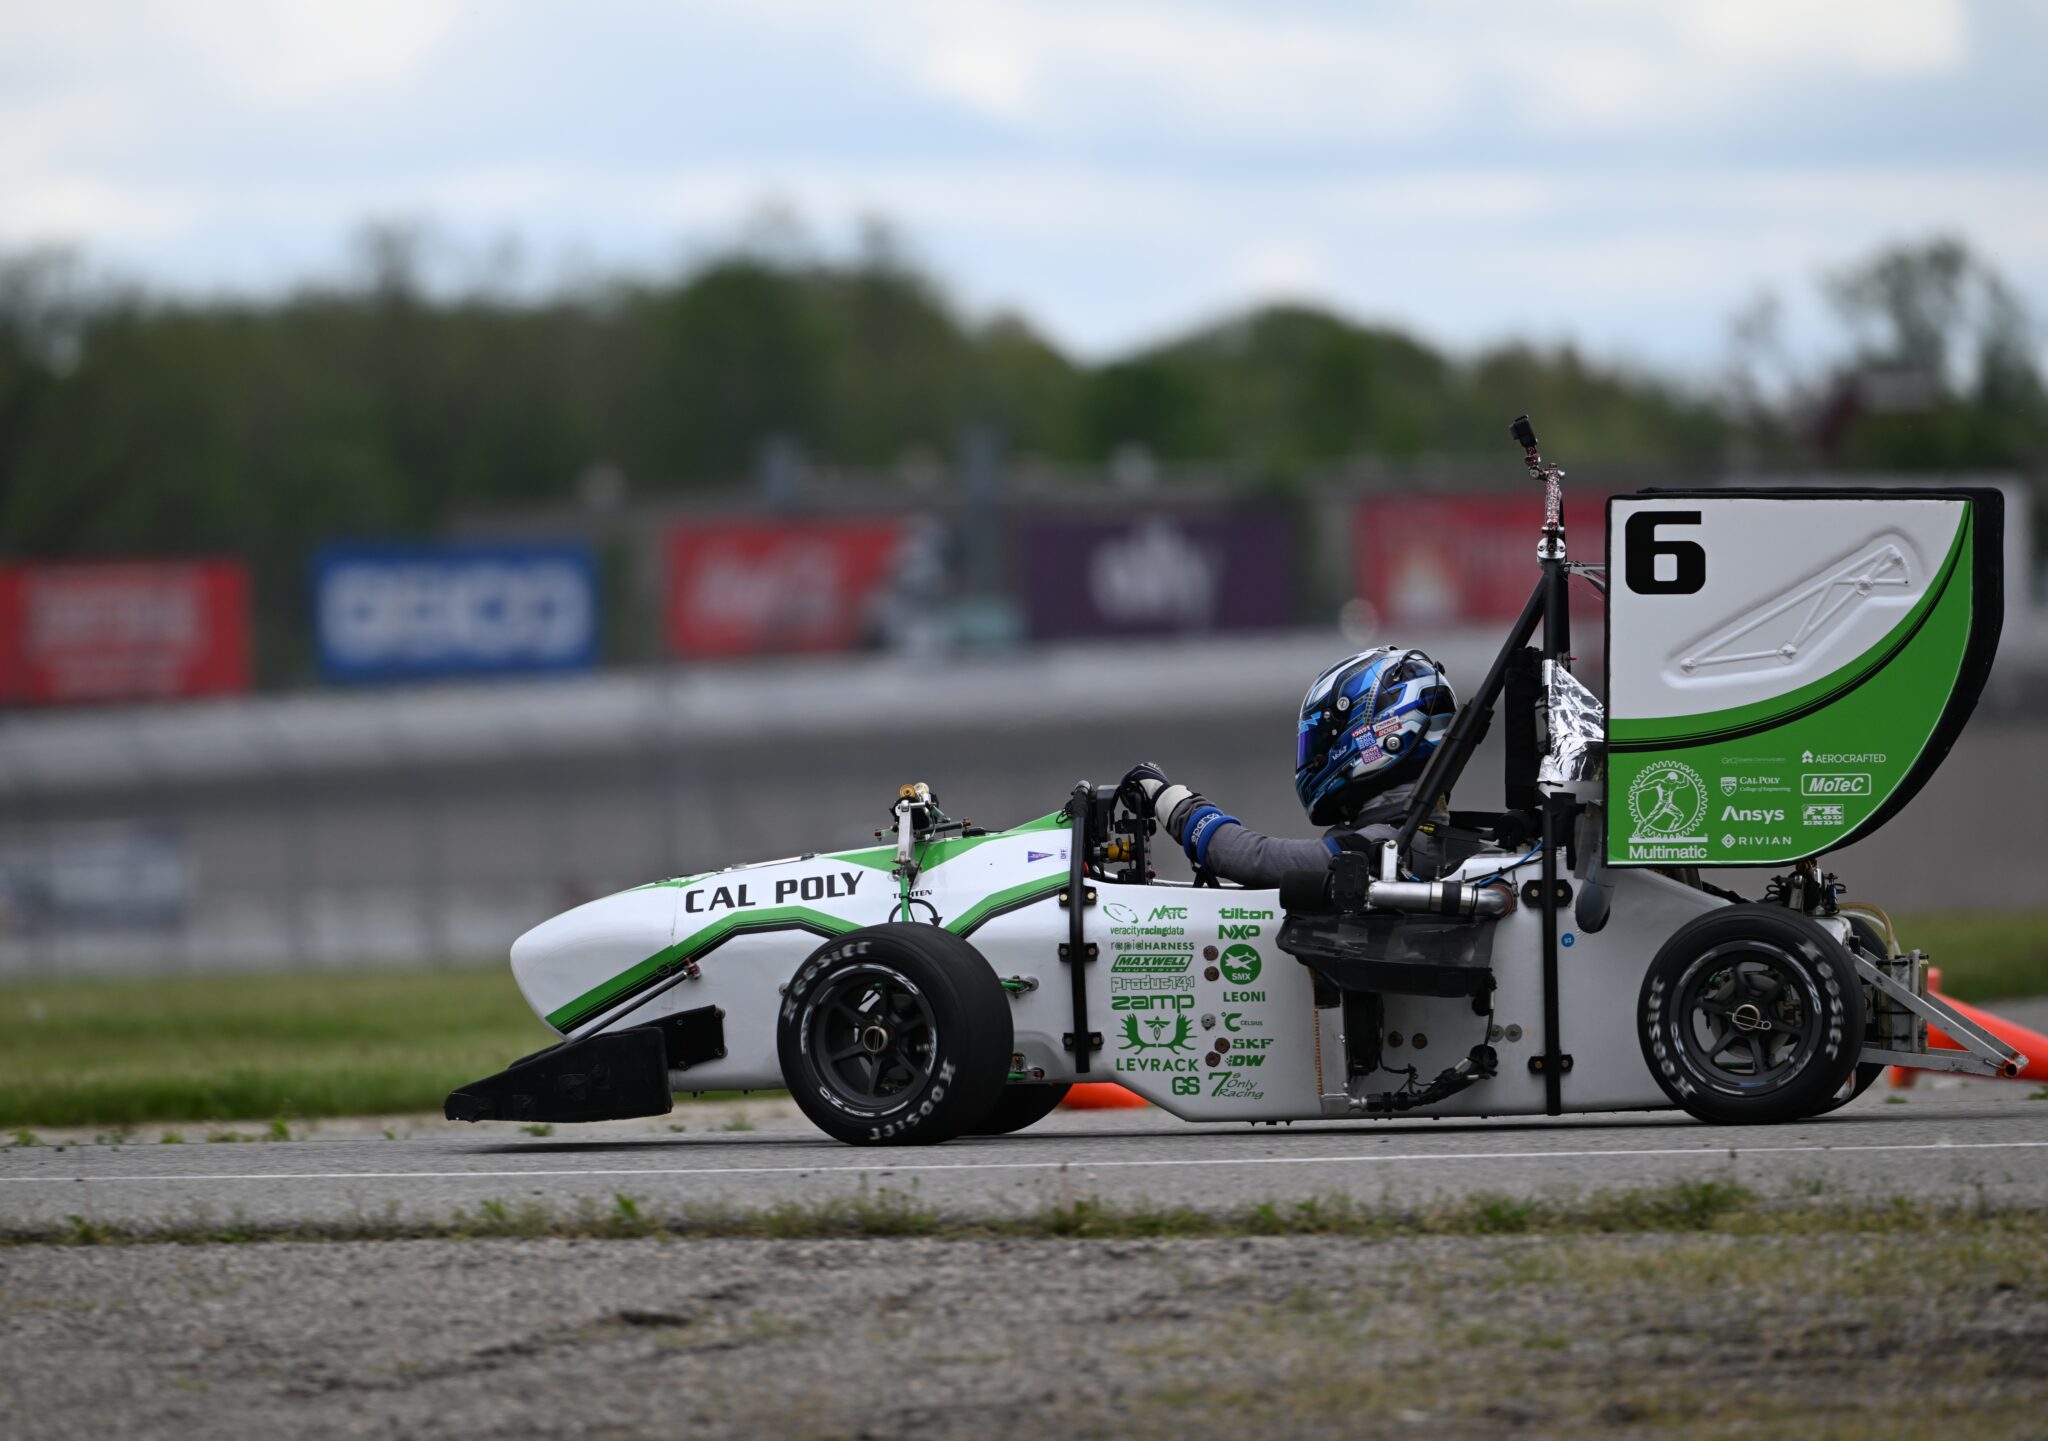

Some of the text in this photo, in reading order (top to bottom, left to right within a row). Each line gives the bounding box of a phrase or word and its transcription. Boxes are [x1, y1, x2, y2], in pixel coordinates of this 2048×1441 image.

[1625, 511, 1706, 595] 6
[1815, 753, 1886, 763] AEROCRAFTED
[1739, 776, 1780, 784] CAL POLY
[1808, 777, 1864, 793] MoTeC
[1721, 806, 1785, 824] Ansys
[1738, 837, 1792, 845] RIVIAN
[1629, 845, 1707, 859] Multimatic
[685, 871, 864, 913] CAL POLY
[1218, 908, 1273, 920] tilton
[1110, 926, 1184, 937] veracityracingdata
[1218, 925, 1260, 940] NXP
[1117, 957, 1186, 966] MAXWELL
[1223, 992, 1266, 1002] LEONI
[1112, 995, 1194, 1013] zamp
[1232, 1039, 1274, 1048] SKF
[1116, 1059, 1199, 1071] LEVRACK
[1231, 1055, 1266, 1066] DW
[1172, 1077, 1200, 1095] GS
[1227, 1079, 1257, 1091] Only
[1217, 1088, 1264, 1099] Racing
